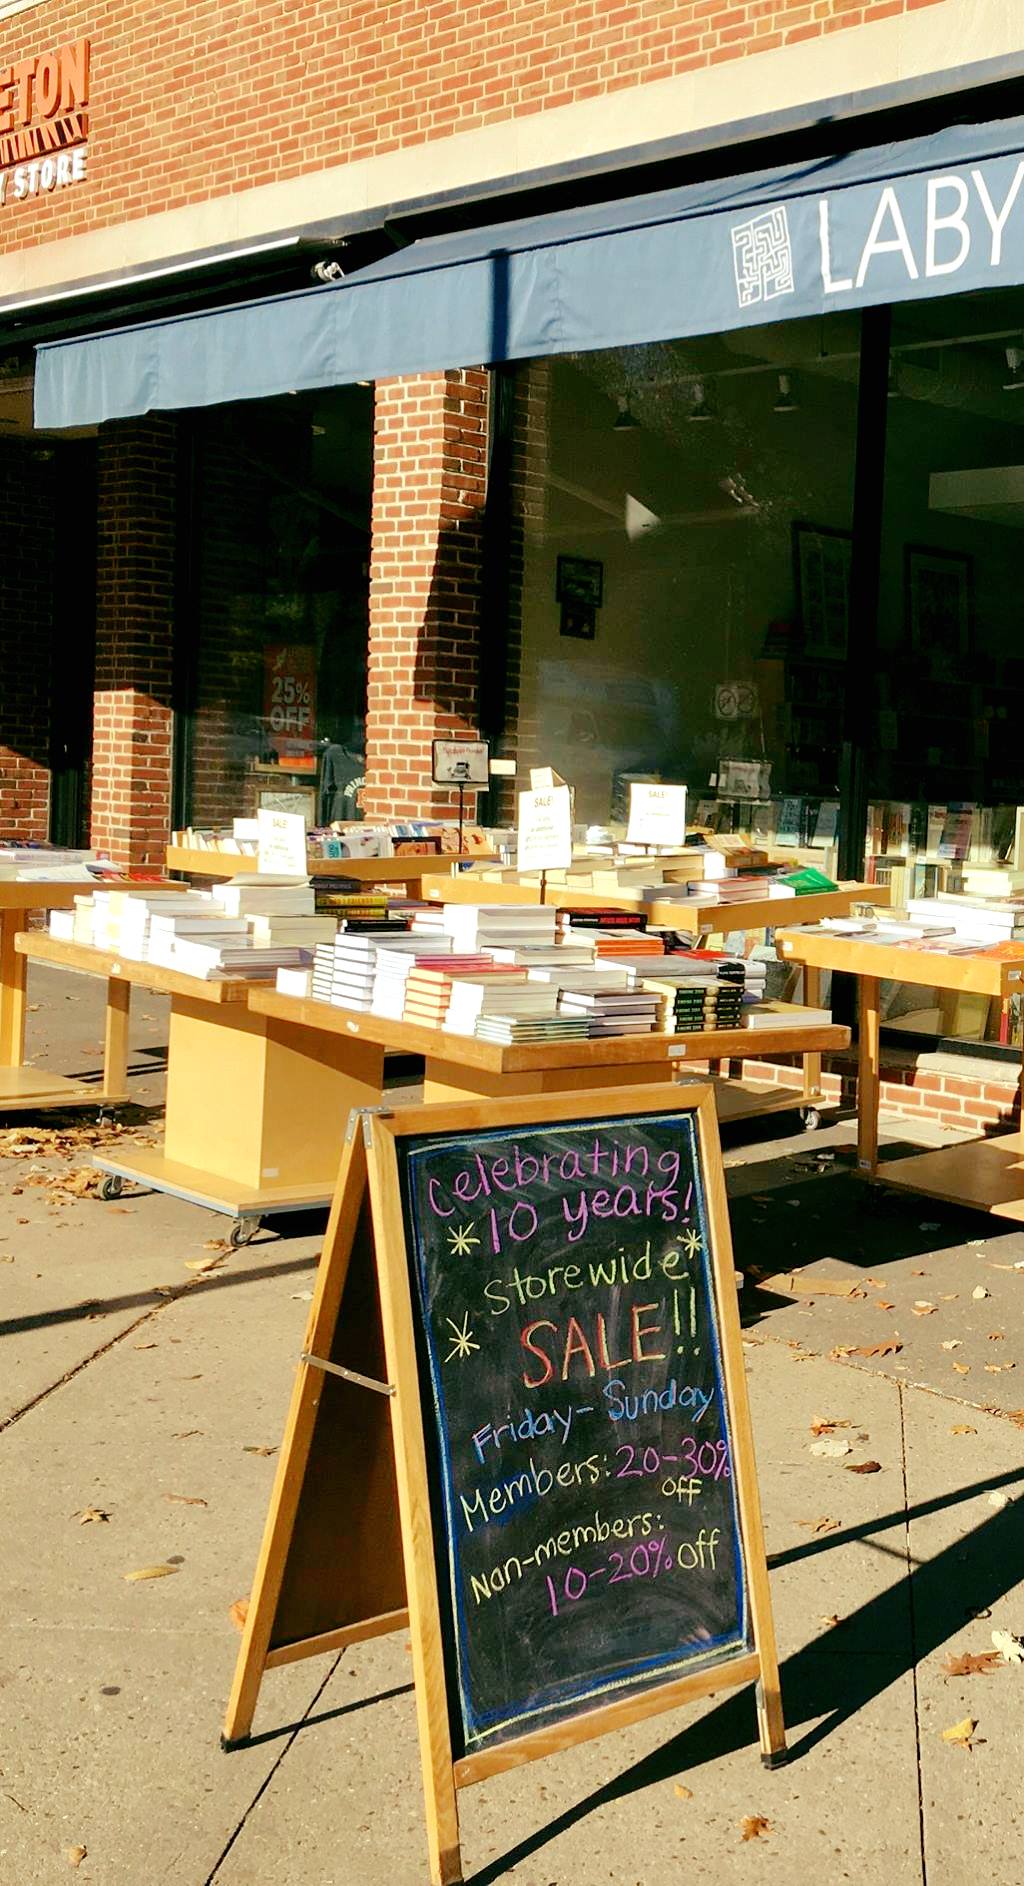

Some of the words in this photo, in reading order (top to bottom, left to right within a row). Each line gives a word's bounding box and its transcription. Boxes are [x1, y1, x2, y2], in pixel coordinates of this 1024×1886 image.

[13, 150, 87, 198] STORE
[270, 705, 312, 732] OFF
[271, 676, 311, 704] 25%
[489, 1202, 538, 1254] 10
[562, 1181, 692, 1242] years!
[520, 1286, 700, 1389] SALE!!
[603, 1378, 715, 1423] Sunday
[459, 1454, 611, 1532] Members:
[616, 1437, 731, 1481] 20-30%
[547, 1536, 672, 1616] 10-20%
[678, 1528, 721, 1570] off
